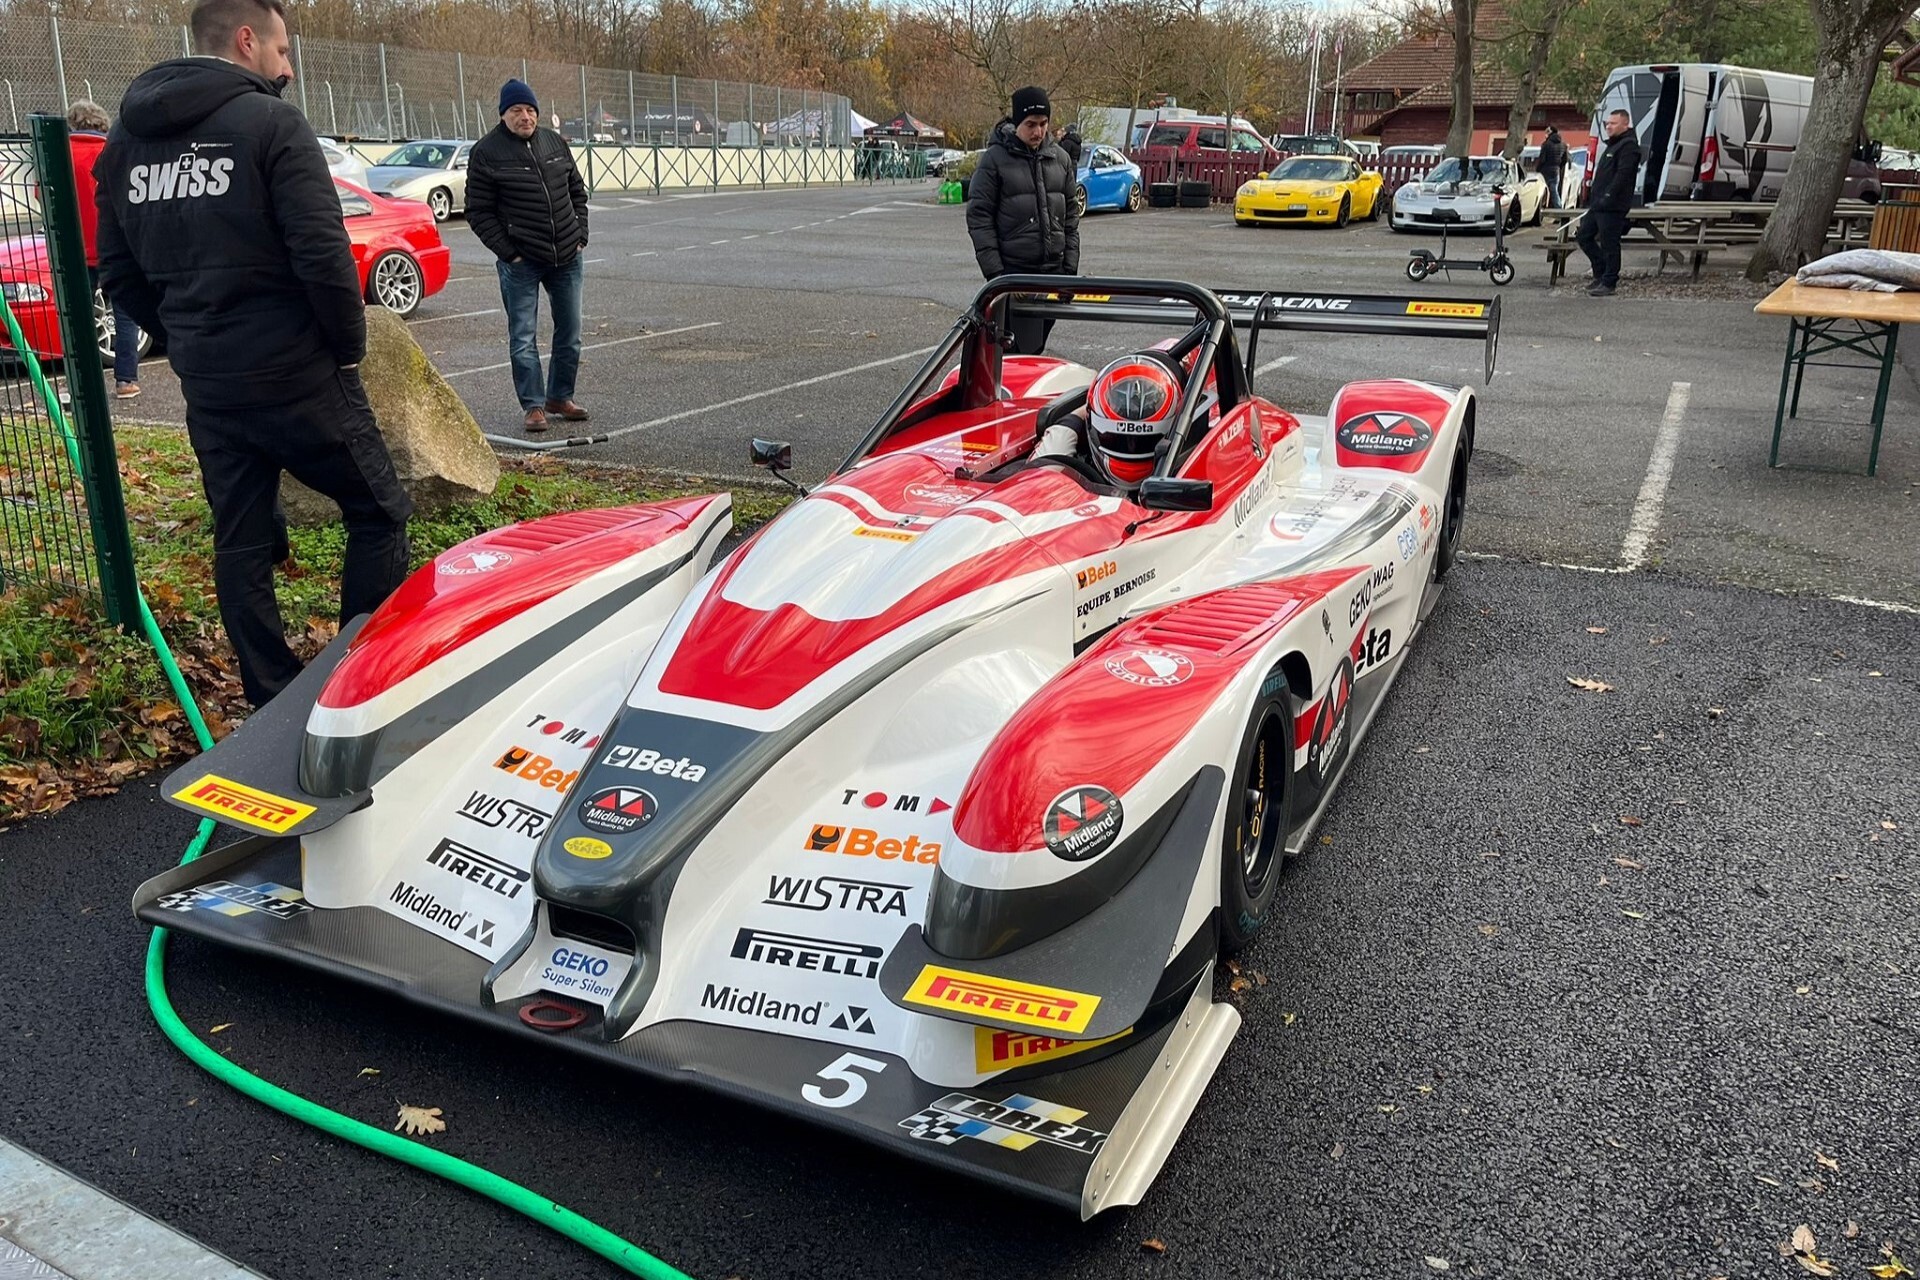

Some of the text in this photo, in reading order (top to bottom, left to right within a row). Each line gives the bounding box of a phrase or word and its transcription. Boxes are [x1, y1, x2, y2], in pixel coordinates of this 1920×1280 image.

[1126, 422, 1153, 433] Beta
[1350, 434, 1414, 448] Midland
[1233, 472, 1271, 529] Midland
[1076, 568, 1156, 618] EQUIPE BERNOISE
[1086, 561, 1117, 586] Beta
[1349, 578, 1371, 628] GEKO
[1372, 561, 1394, 589] WAG
[1131, 649, 1189, 666] AUTO
[516, 754, 580, 794] Bet
[628, 748, 707, 783] Beta
[191, 782, 298, 824] PIRELLI
[586, 808, 638, 828] Midland
[842, 828, 942, 865] Beta
[1063, 812, 1115, 853] Midland
[1075, 845, 1091, 857] Swiss
[1089, 835, 1107, 848] Quality
[426, 837, 531, 900] PIRELLI
[389, 881, 469, 932] Midland
[761, 875, 914, 917] WISTRA
[551, 947, 609, 977] GEKO
[730, 927, 884, 980] PIRELLI
[541, 967, 615, 998] Super Silent
[925, 975, 1079, 1023] PIRELLI
[700, 983, 823, 1026] Midland
[801, 1051, 888, 1108] 5
